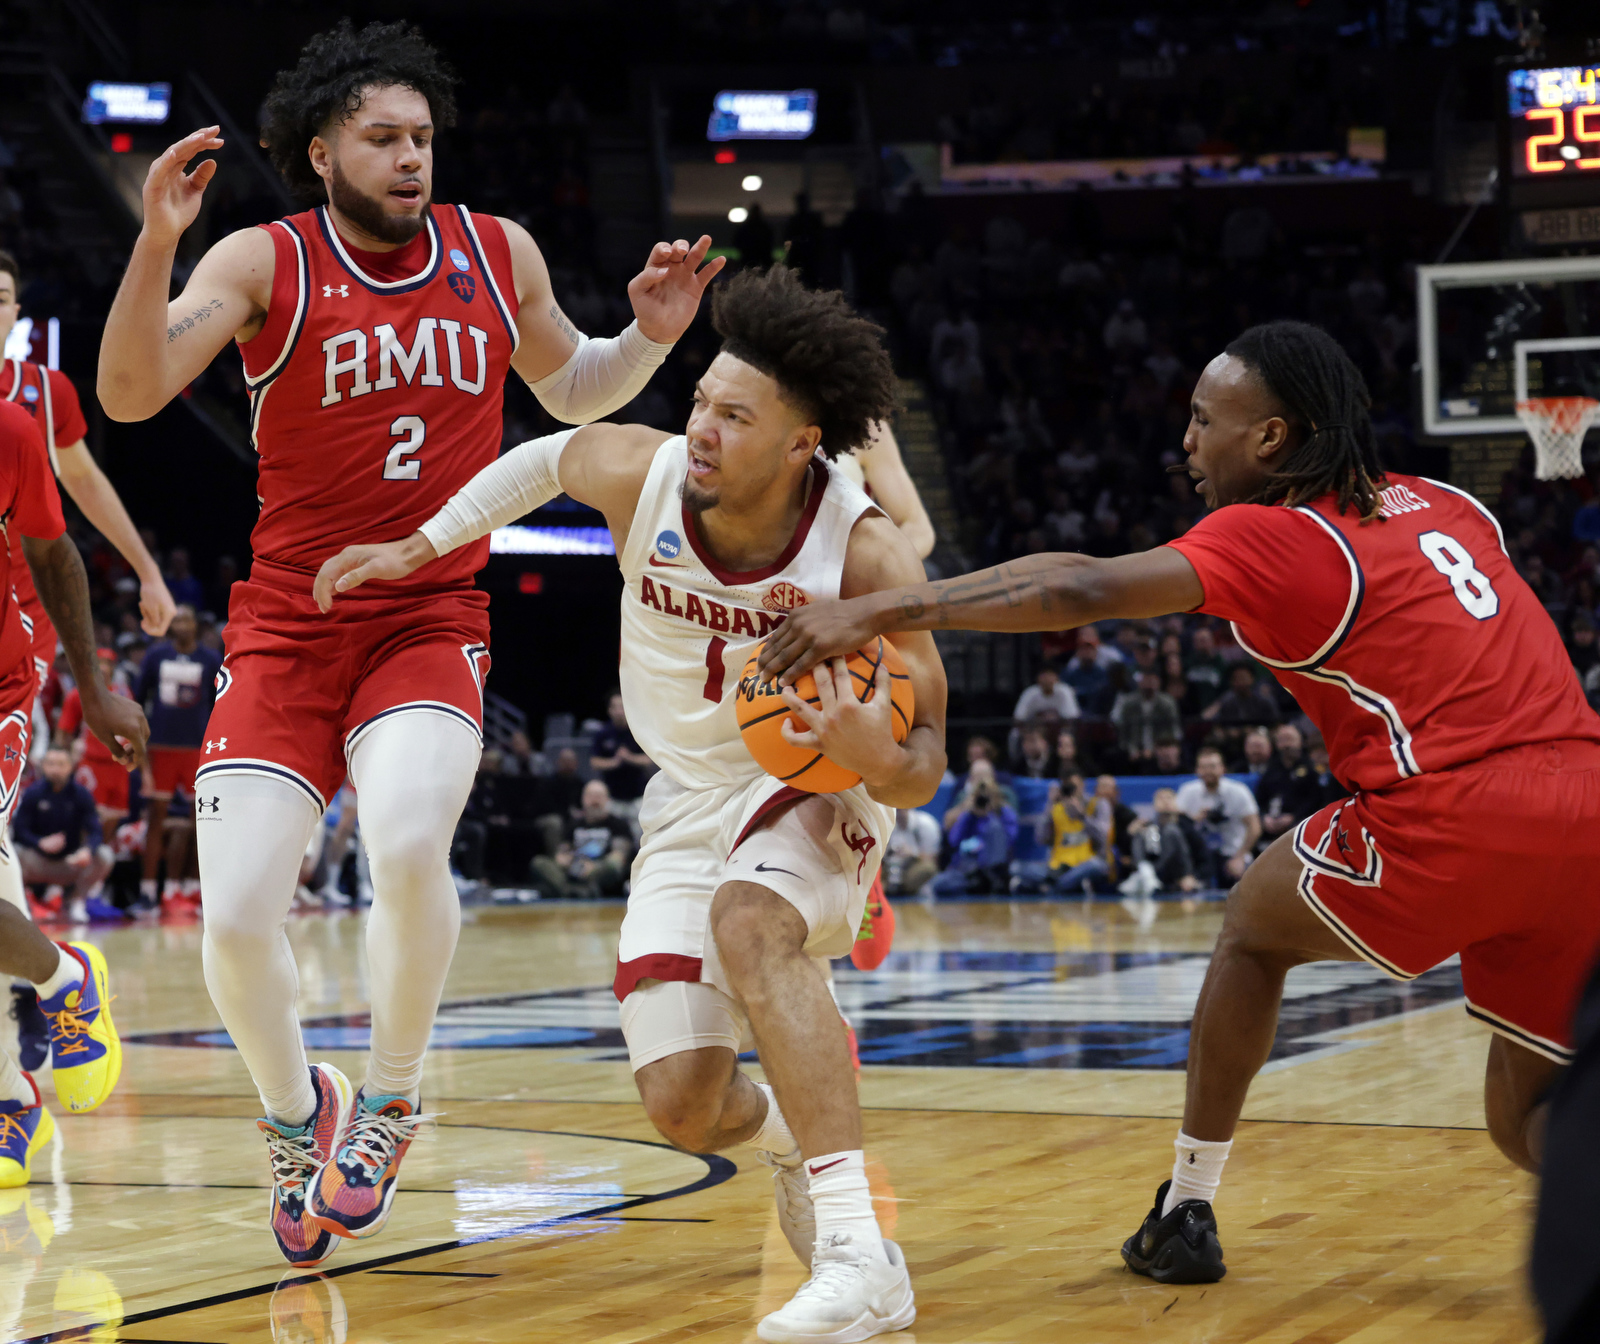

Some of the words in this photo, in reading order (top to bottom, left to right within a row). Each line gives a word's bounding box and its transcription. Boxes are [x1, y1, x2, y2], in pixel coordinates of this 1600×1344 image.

[320, 316, 489, 409] RMU
[381, 414, 427, 481] 2
[1370, 484, 1431, 519] OODS
[658, 540, 678, 556] NCAA
[1417, 530, 1499, 621] 8
[640, 574, 790, 639] ALABAM
[772, 583, 804, 609] SEC
[703, 635, 729, 705] 1
